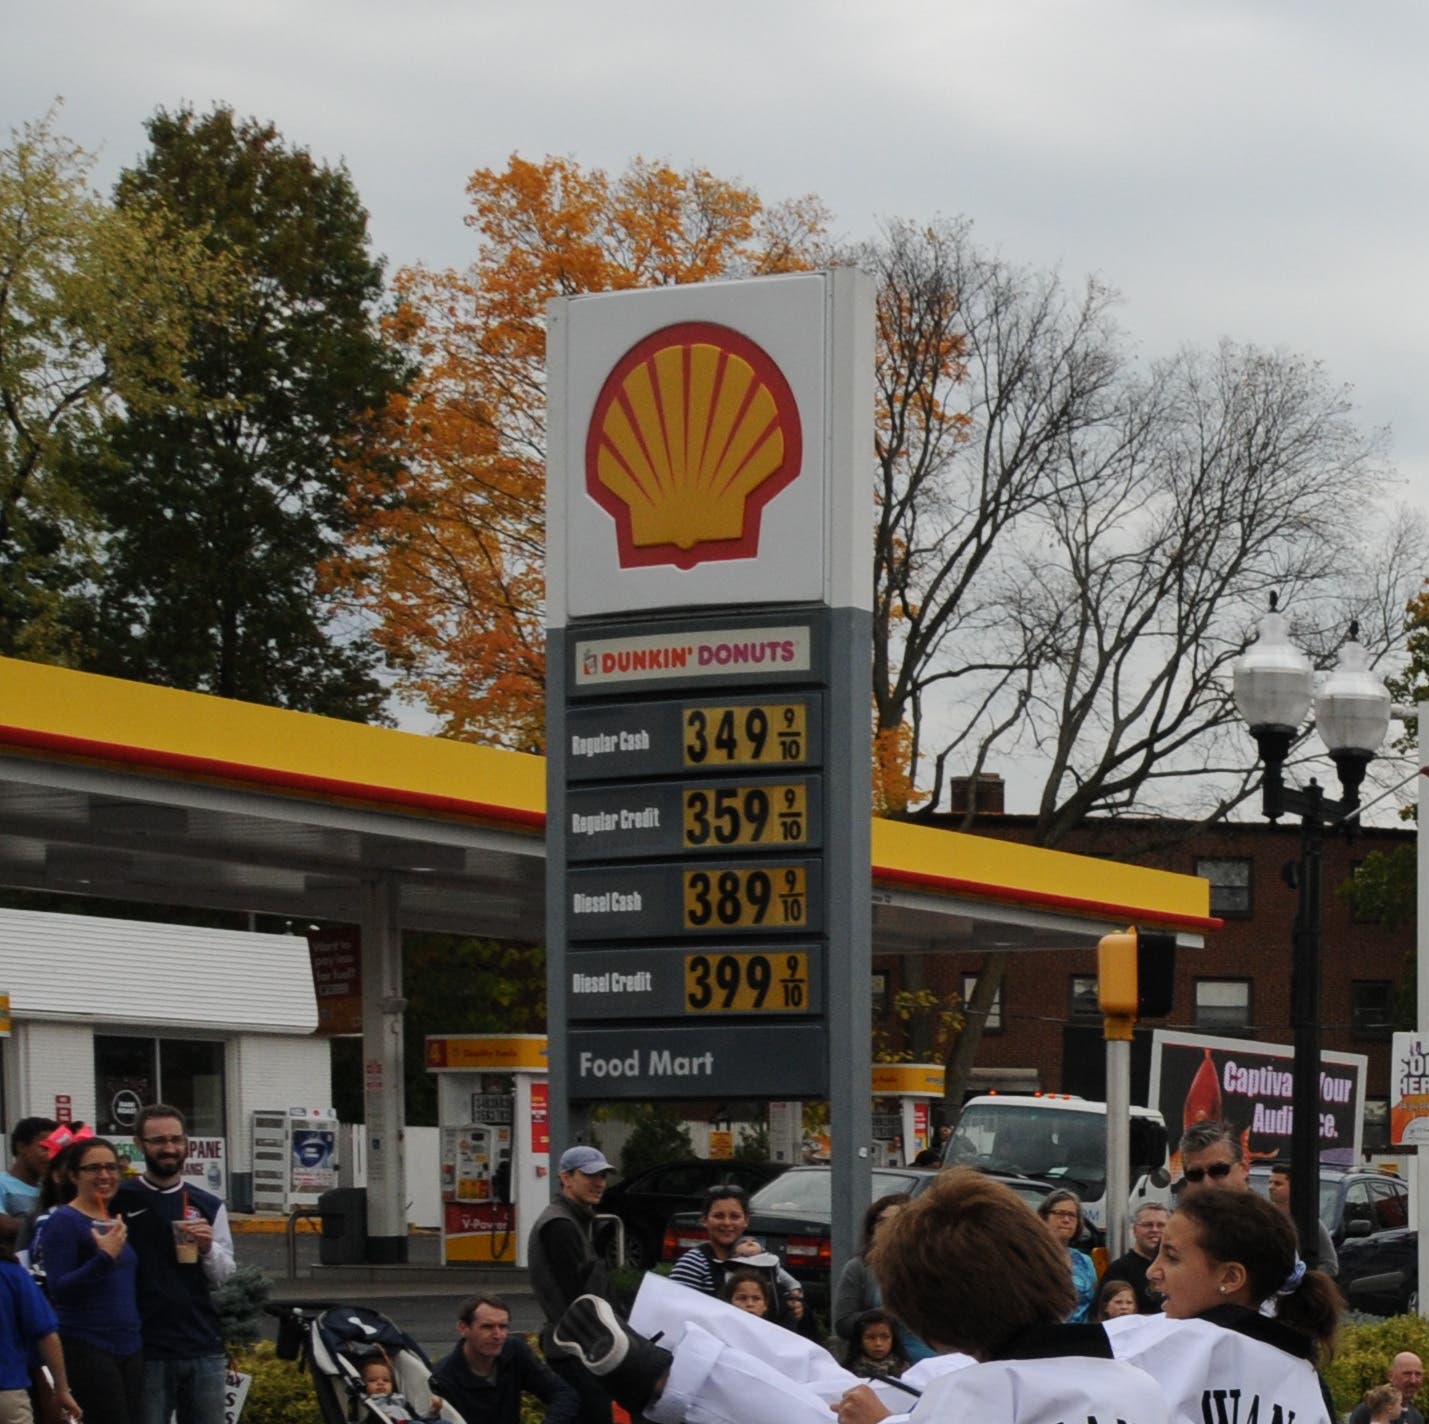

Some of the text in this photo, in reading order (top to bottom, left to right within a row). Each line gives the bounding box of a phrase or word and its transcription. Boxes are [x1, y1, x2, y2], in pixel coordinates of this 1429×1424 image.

[601, 640, 794, 673] DUNKIN' DONUTS
[572, 730, 650, 757] Regular Cash
[687, 708, 768, 763] 349
[572, 808, 660, 835] Regular Credit
[687, 789, 769, 844] 359
[573, 891, 642, 913] Diesel Cash
[688, 871, 771, 925] 389
[573, 972, 652, 993] Diesel Credit
[688, 955, 772, 1009] 399
[580, 1050, 714, 1077] Food Mart
[1223, 1061, 1293, 1097] Captiva
[1252, 1103, 1339, 1138] Audie.
[184, 1141, 221, 1158] PANE
